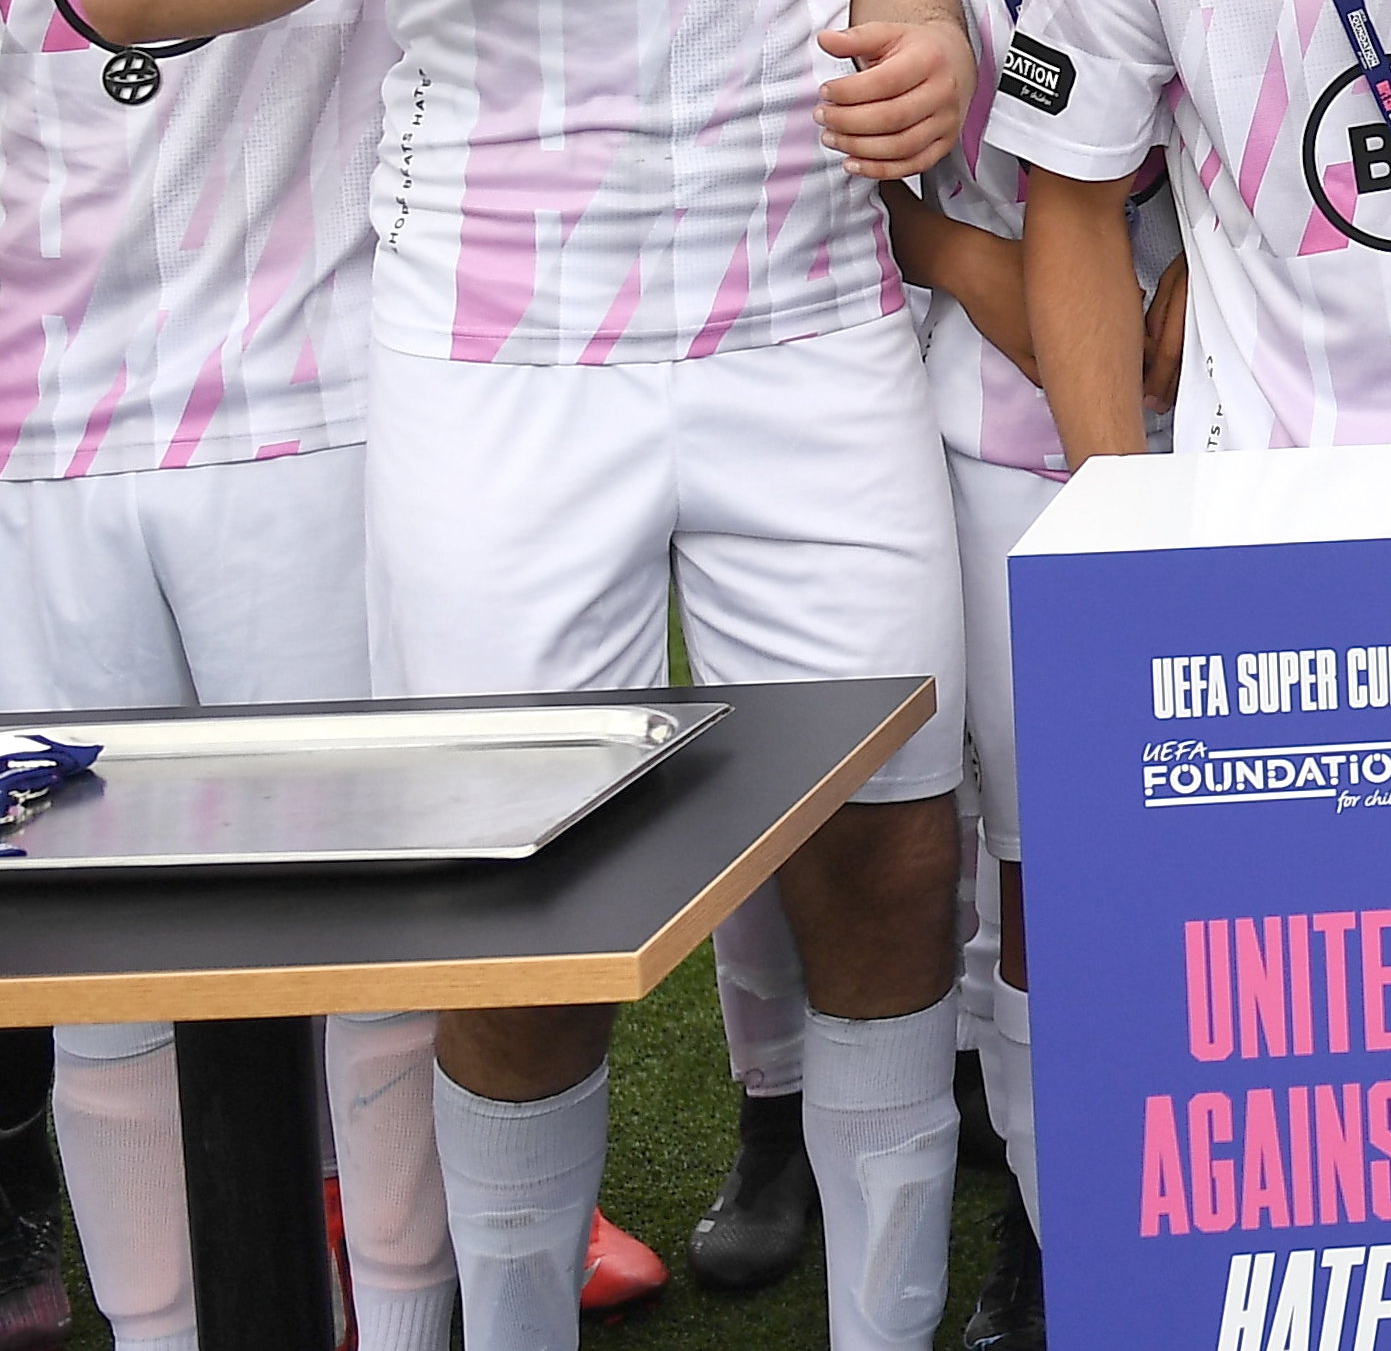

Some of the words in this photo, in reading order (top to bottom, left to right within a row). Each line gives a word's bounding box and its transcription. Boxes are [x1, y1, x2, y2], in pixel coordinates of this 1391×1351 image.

[1152, 655, 1231, 721] UEFA
[1237, 648, 1339, 717] SUPER
[1142, 739, 1208, 763] UEFA
[1335, 790, 1362, 814] for
